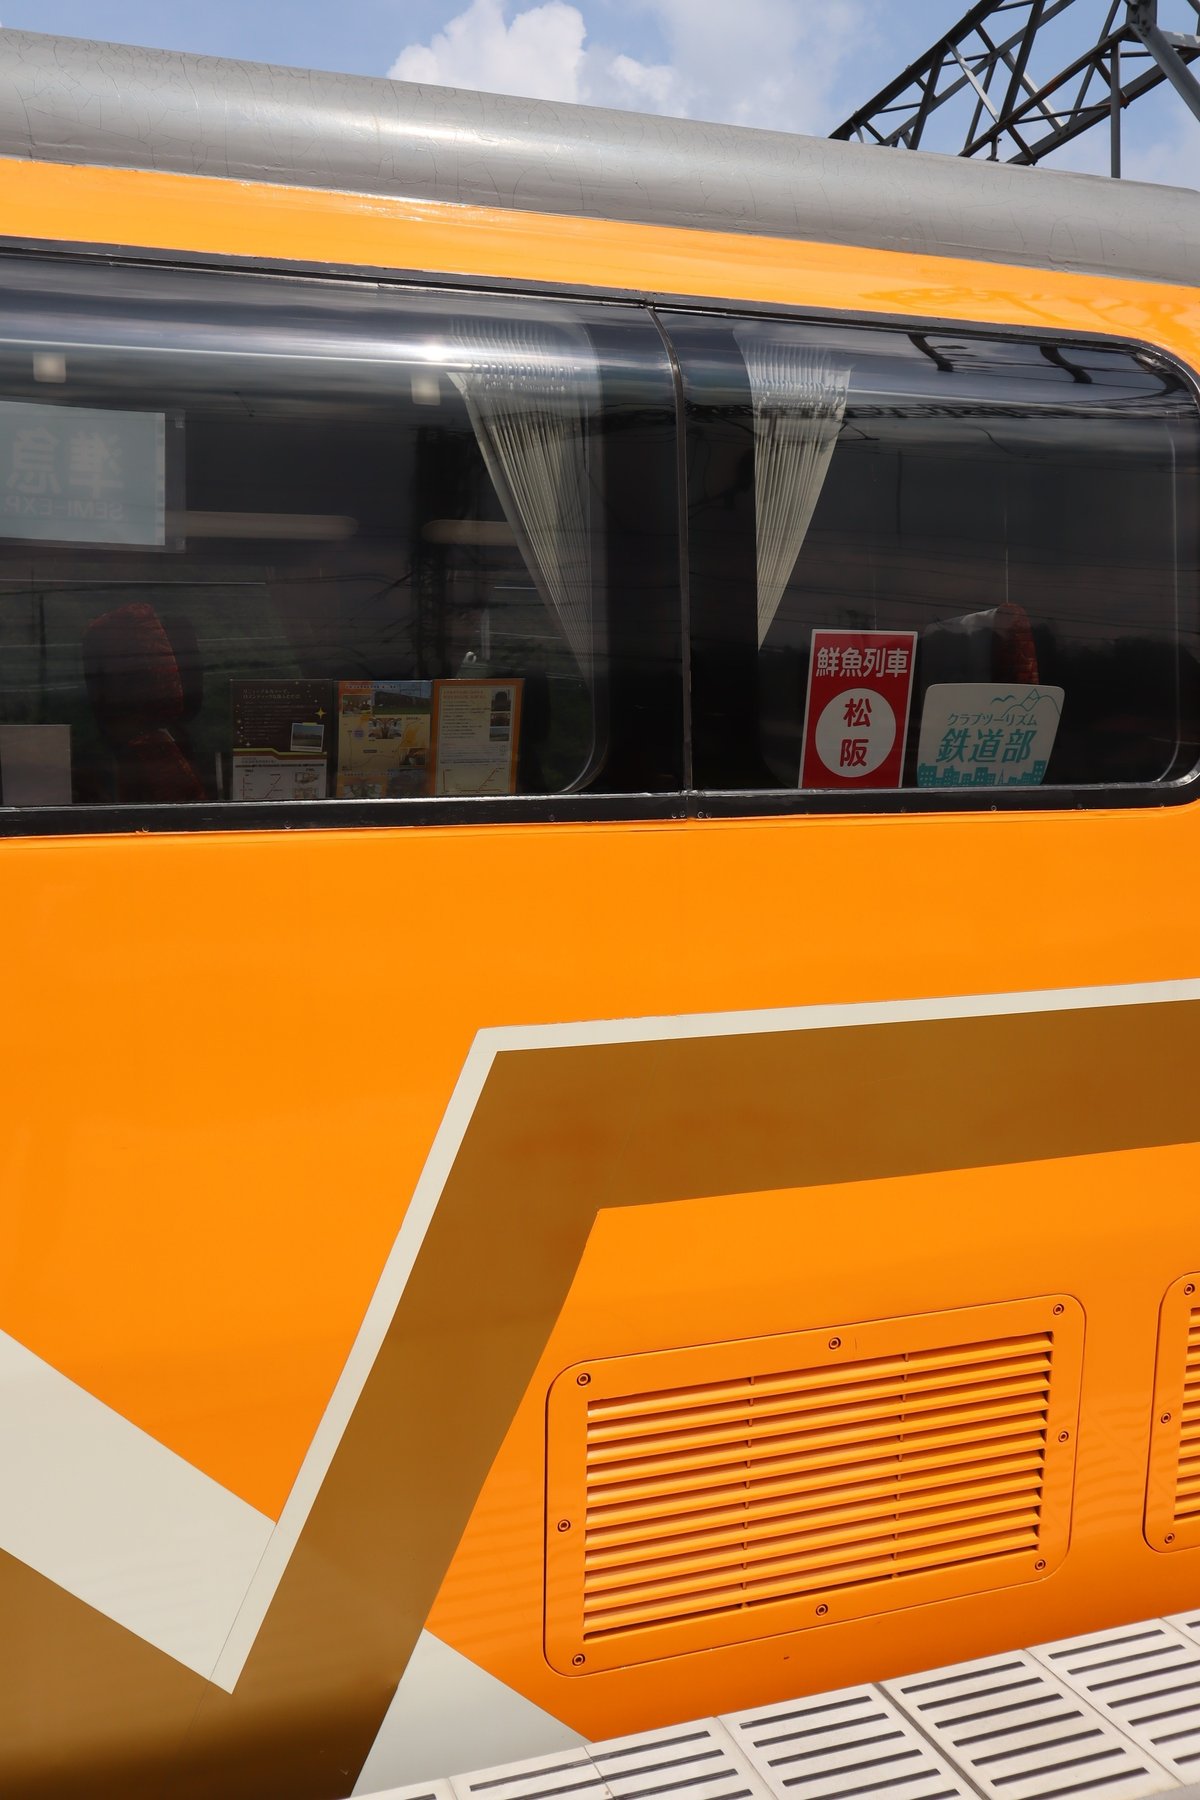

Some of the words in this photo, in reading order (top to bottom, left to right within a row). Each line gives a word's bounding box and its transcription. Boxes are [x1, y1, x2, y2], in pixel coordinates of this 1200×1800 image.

[815, 647, 910, 678] 鮮魚列車
[946, 711, 1038, 727] クラブツーリズム
[935, 727, 1038, 764] 鉄道部
